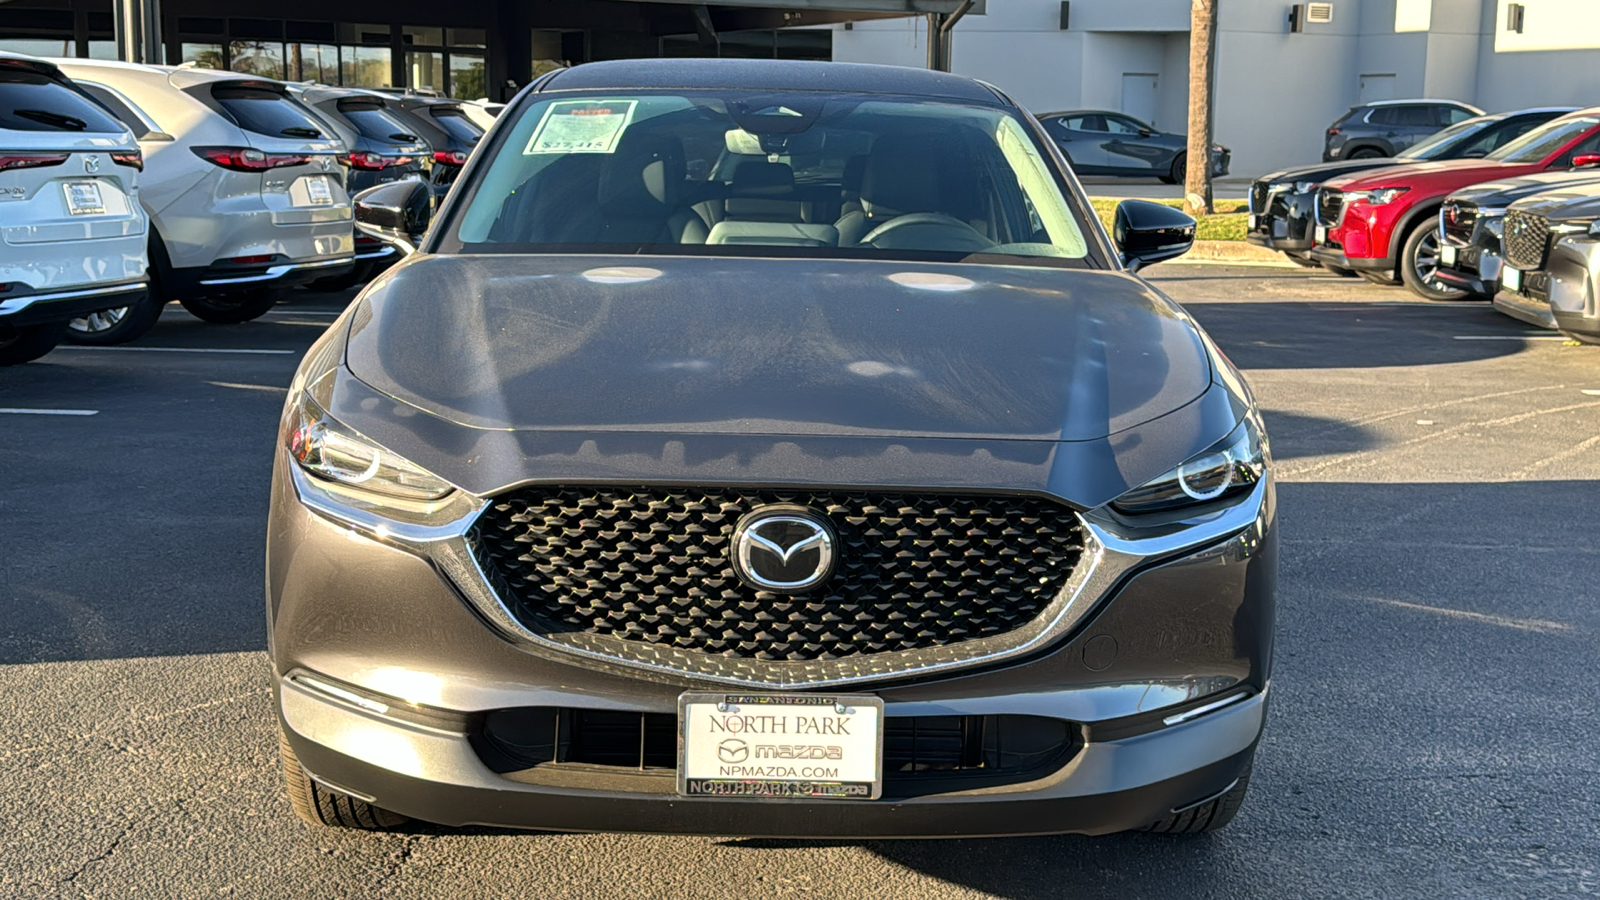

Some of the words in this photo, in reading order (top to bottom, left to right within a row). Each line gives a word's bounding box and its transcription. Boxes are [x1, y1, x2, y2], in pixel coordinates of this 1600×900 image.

[709, 714, 786, 735] NORTH
[795, 716, 851, 735] PARK
[755, 744, 842, 760] mazda
[719, 766, 838, 778] NPMAZDA.COM
[690, 780, 744, 794] NORTH
[751, 781, 791, 795] PARK
[817, 783, 868, 795] mazda
